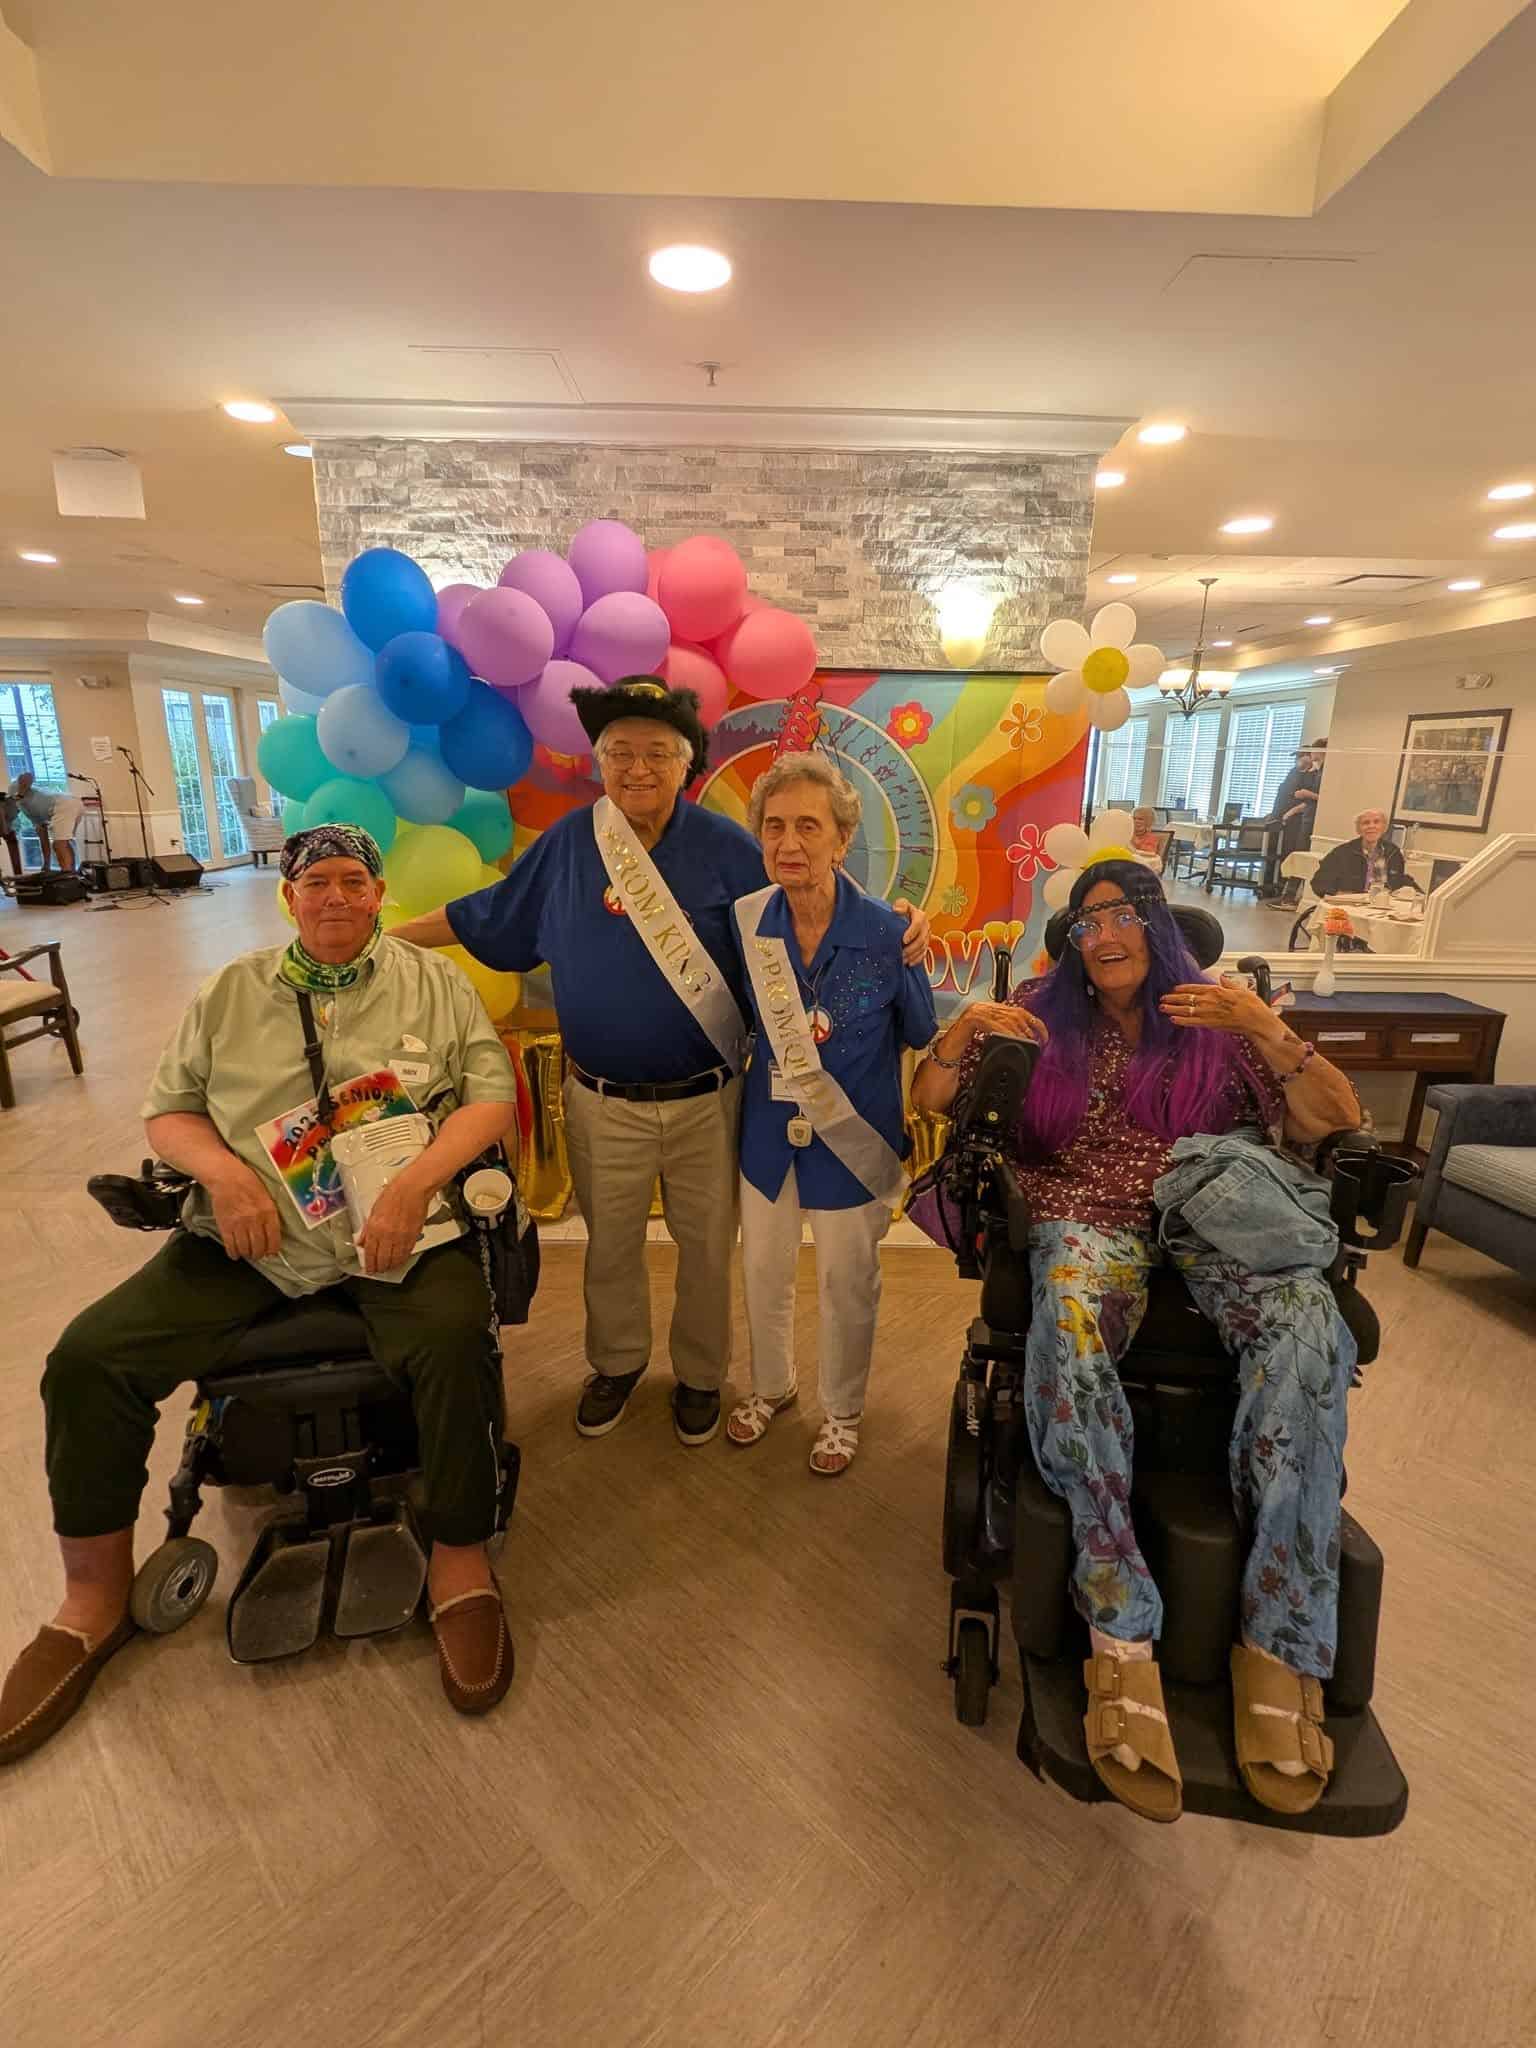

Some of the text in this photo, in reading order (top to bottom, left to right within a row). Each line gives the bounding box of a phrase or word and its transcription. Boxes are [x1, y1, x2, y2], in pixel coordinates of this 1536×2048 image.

[653, 923, 712, 993] KING
[760, 960, 801, 1041] PROM
[327, 1087, 394, 1110] SENIOR
